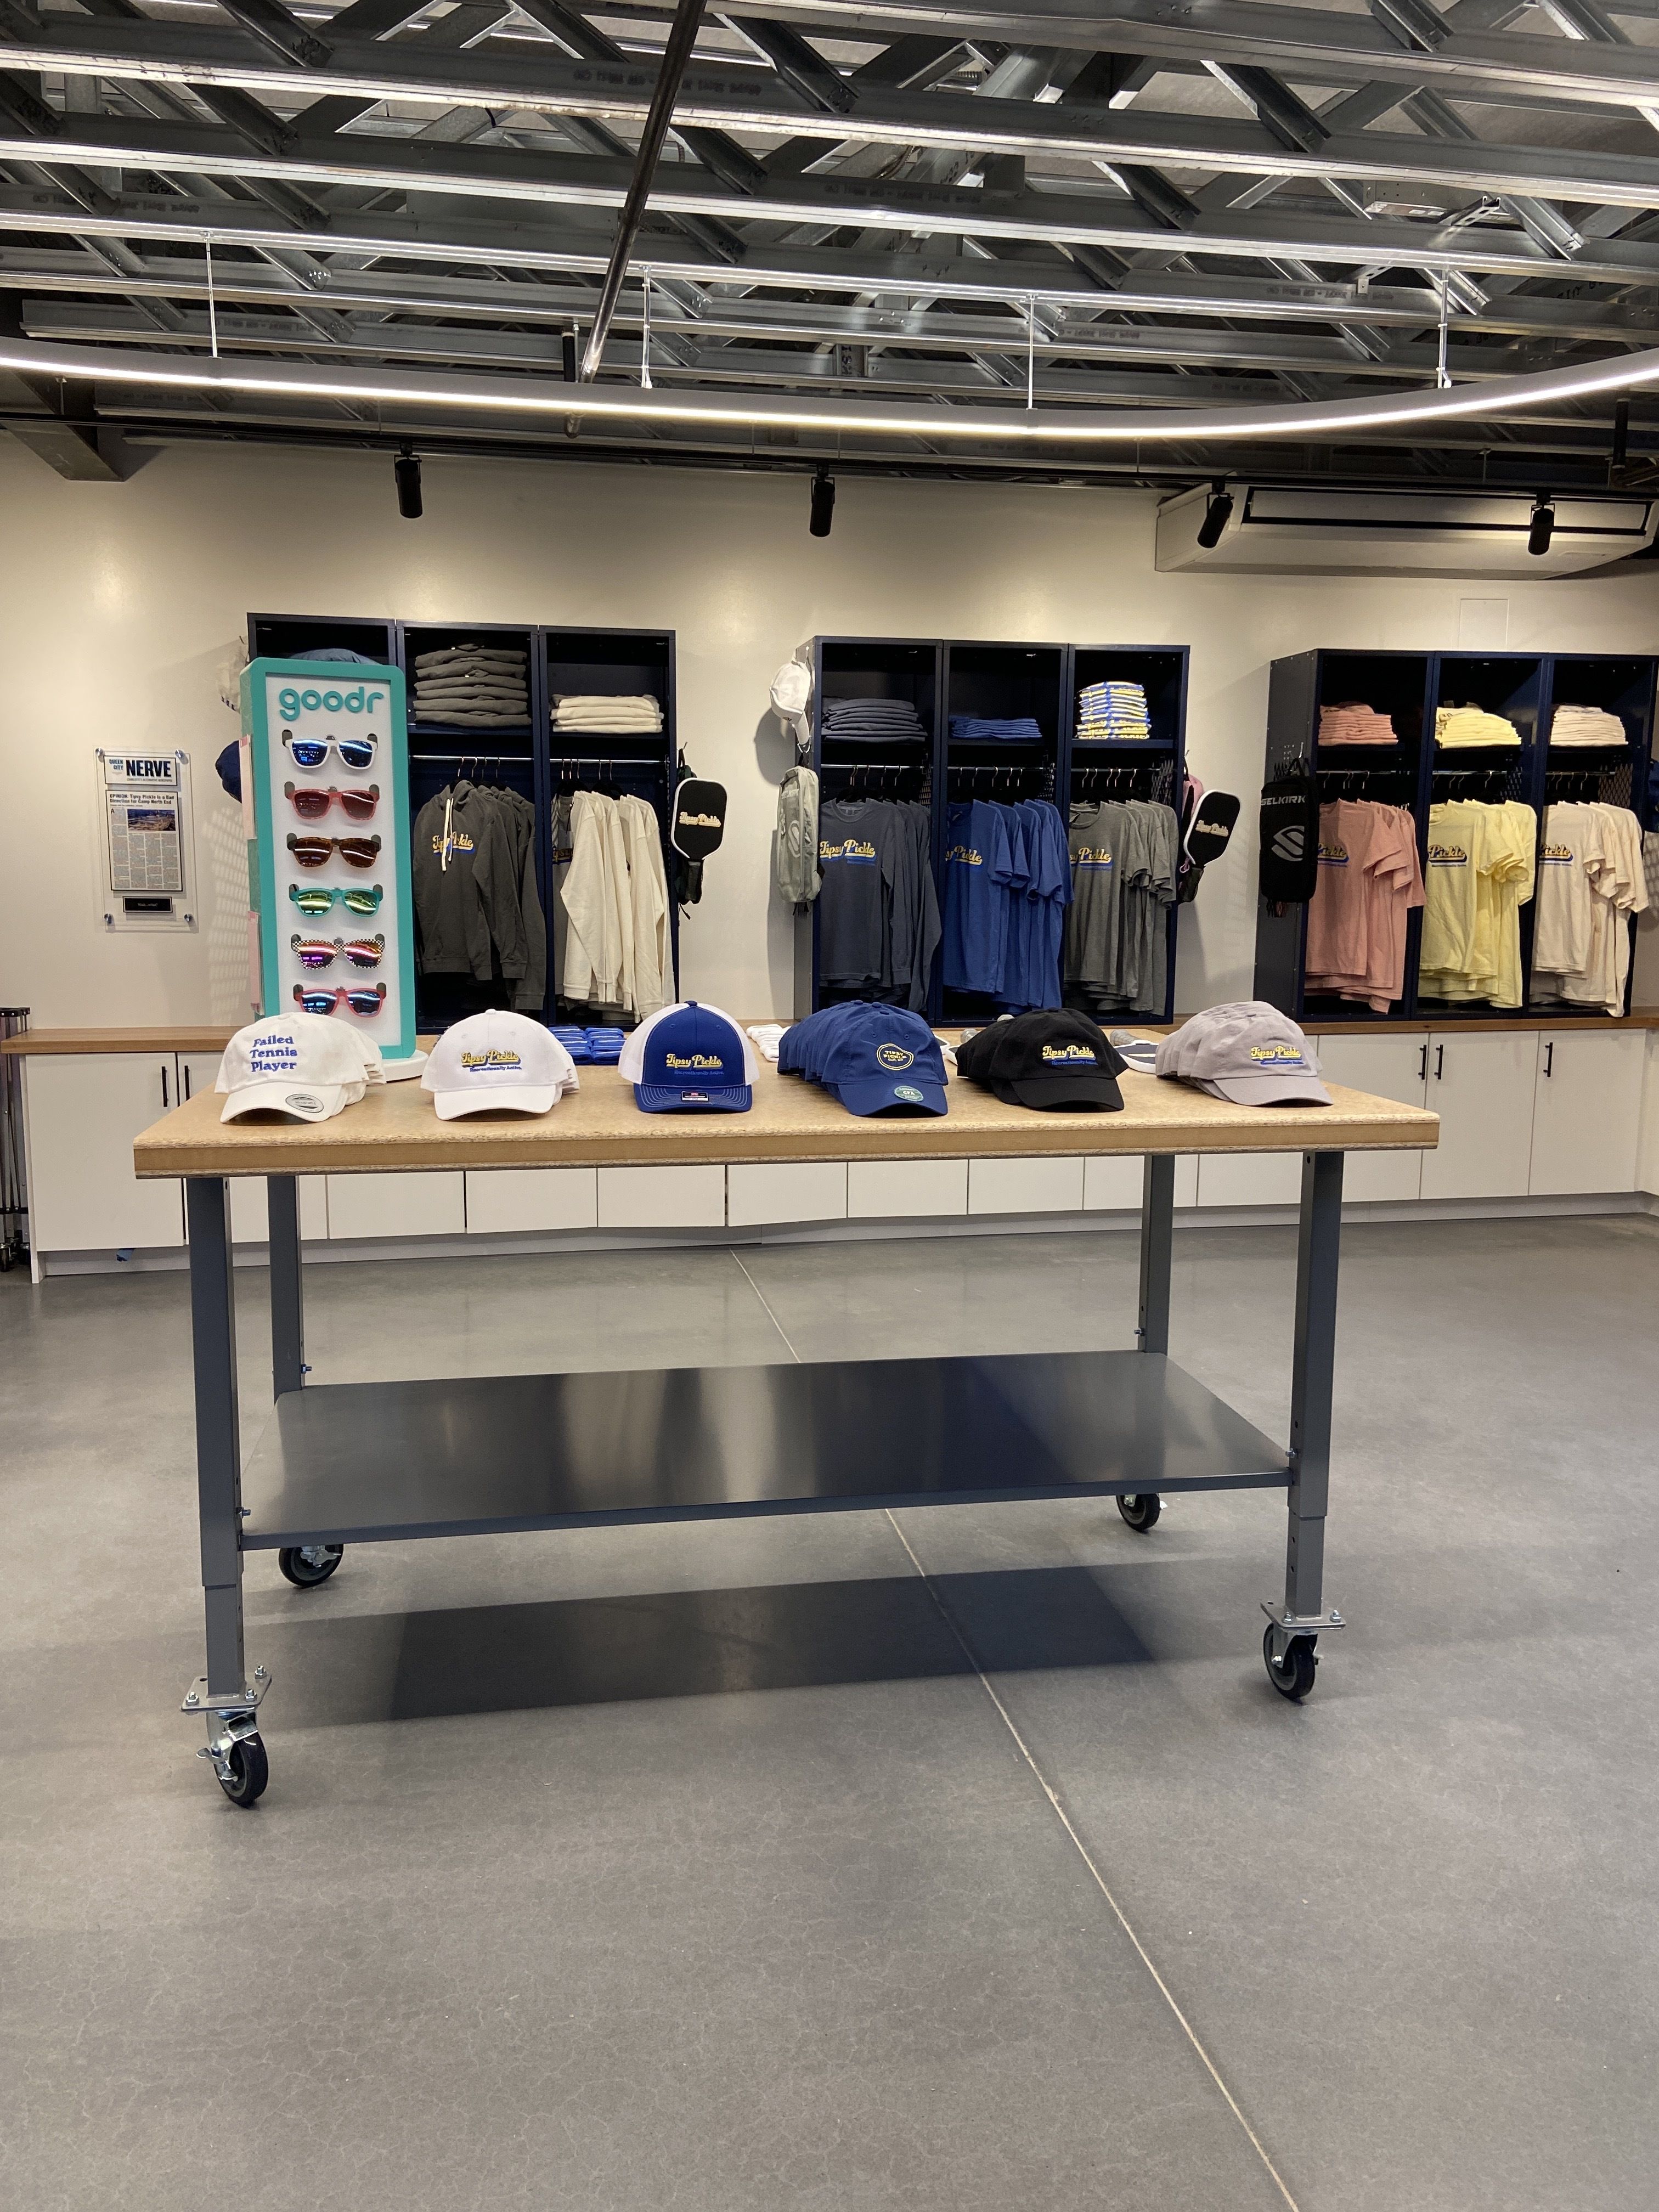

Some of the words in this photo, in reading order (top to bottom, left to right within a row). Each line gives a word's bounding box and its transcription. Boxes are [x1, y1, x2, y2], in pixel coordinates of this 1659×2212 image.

[279, 686, 384, 721] goodr
[126, 760, 172, 777] NERVE
[1261, 795, 1306, 806] SELKIRK
[432, 835, 450, 853] Tip
[820, 840, 844, 859] Tipsy
[844, 839, 876, 858] Pickle
[252, 1035, 295, 1048] Failed
[250, 1047, 298, 1059] Tennis
[461, 1052, 487, 1066] Tipsy
[487, 1049, 521, 1065] Pickle
[1042, 1046, 1068, 1060] Tipsy
[1068, 1045, 1096, 1060] Pickle
[1251, 1046, 1276, 1060] Tipsy
[251, 1062, 297, 1072] Player
[666, 1053, 691, 1069] Tipsy
[691, 1054, 723, 1069] Pickle
